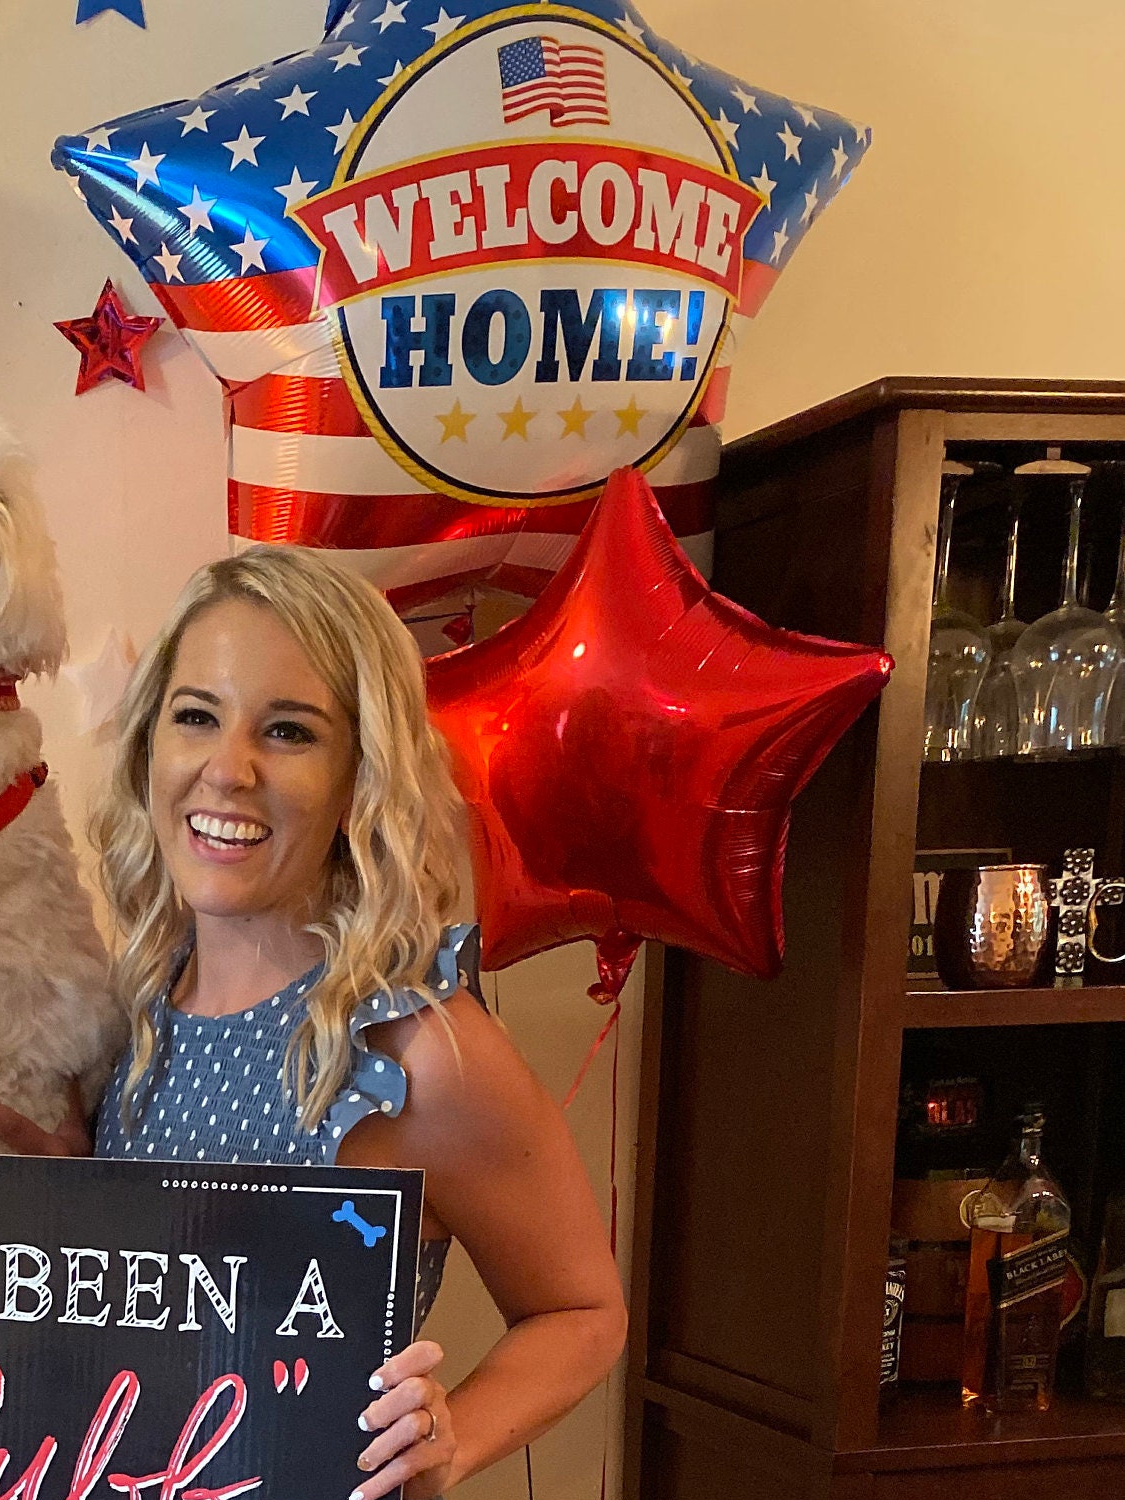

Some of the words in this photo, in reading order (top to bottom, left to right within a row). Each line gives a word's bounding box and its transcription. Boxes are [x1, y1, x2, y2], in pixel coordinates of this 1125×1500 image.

[323, 159, 741, 285] WELCOME
[379, 289, 706, 388] HOME!
[275, 1258, 344, 1339] A
[1006, 1261, 1038, 1280] BLACK
